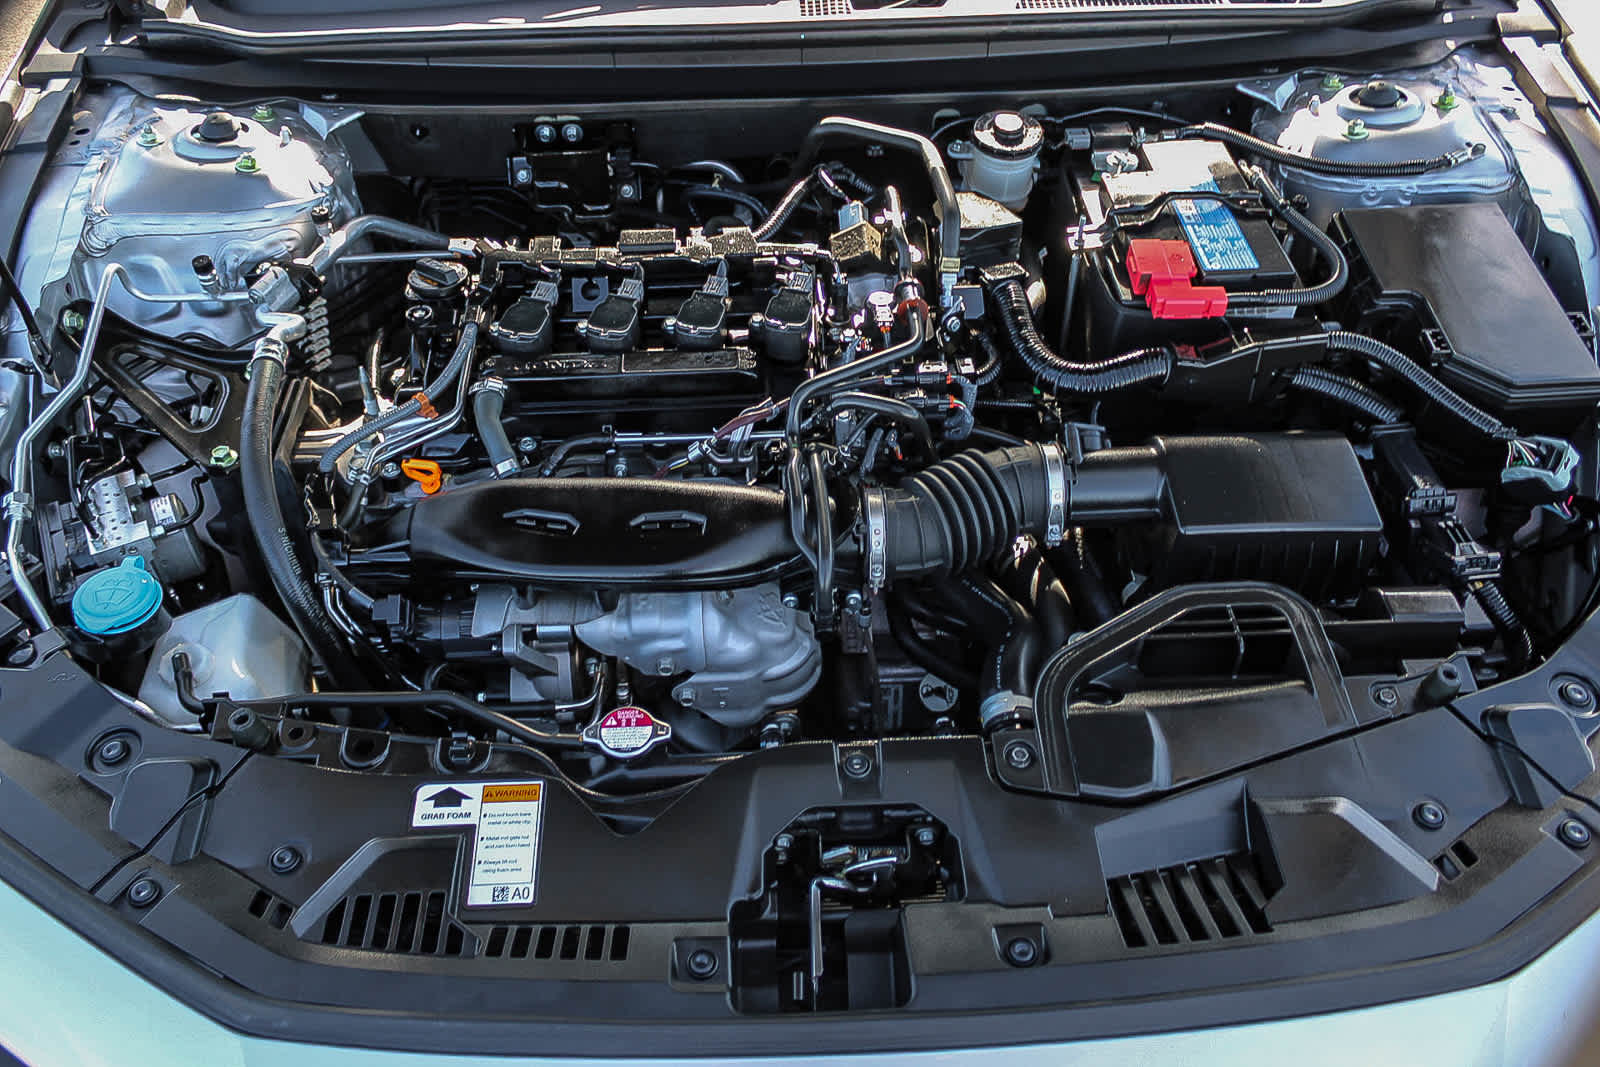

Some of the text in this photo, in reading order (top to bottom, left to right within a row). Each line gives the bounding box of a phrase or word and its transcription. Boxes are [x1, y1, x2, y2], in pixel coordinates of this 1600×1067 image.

[495, 788, 537, 798] WARNING
[421, 811, 472, 821] GRAB FOAM
[511, 886, 530, 901] A0
